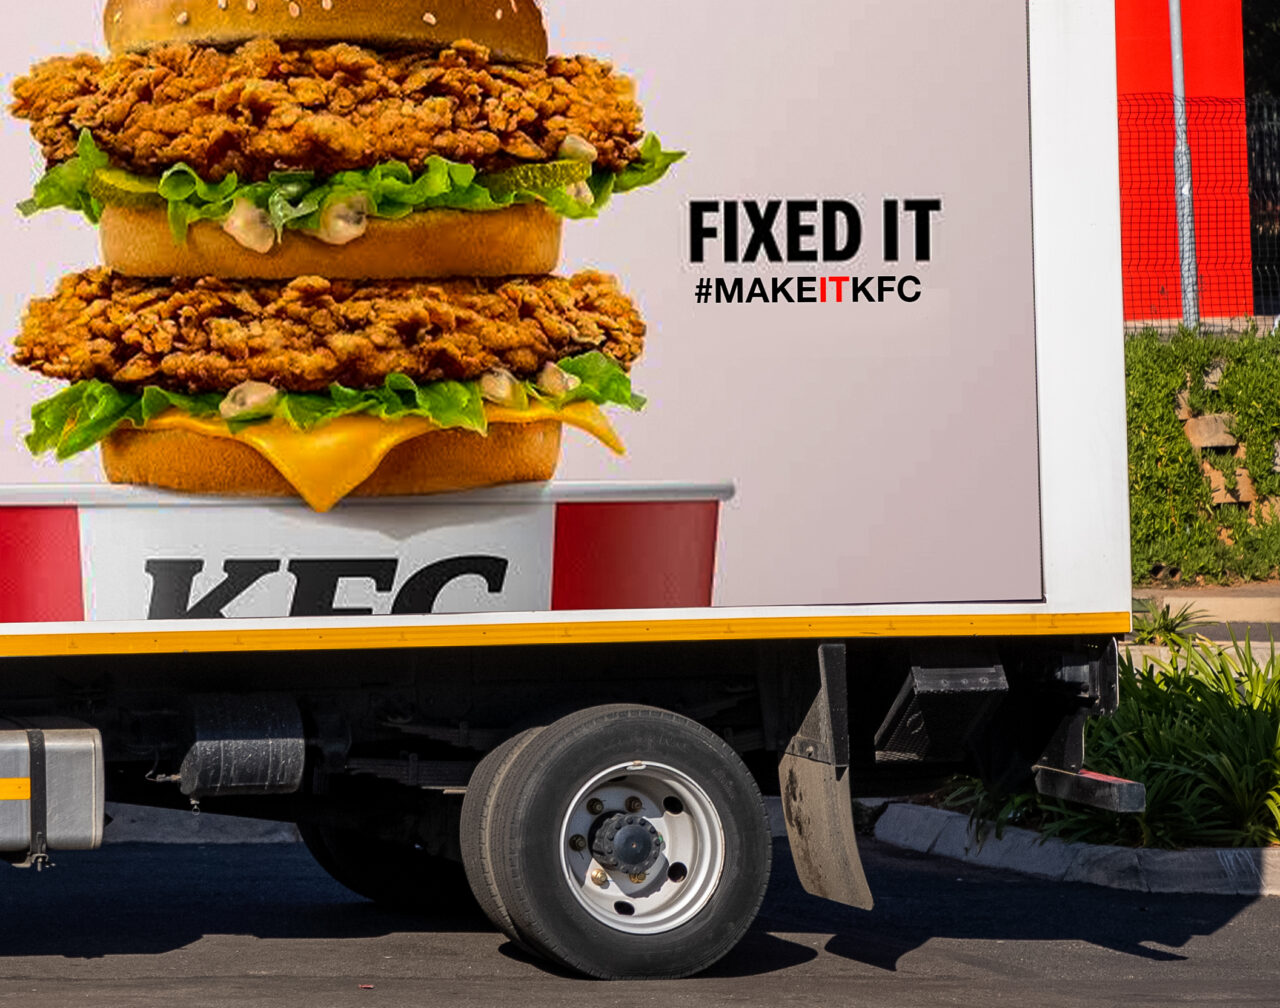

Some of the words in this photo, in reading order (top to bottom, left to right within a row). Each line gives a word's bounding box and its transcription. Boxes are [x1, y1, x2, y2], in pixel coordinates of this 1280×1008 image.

[689, 199, 862, 263] FIXED
[883, 199, 941, 262] IT
[694, 275, 922, 304] #MAKEITKFC
